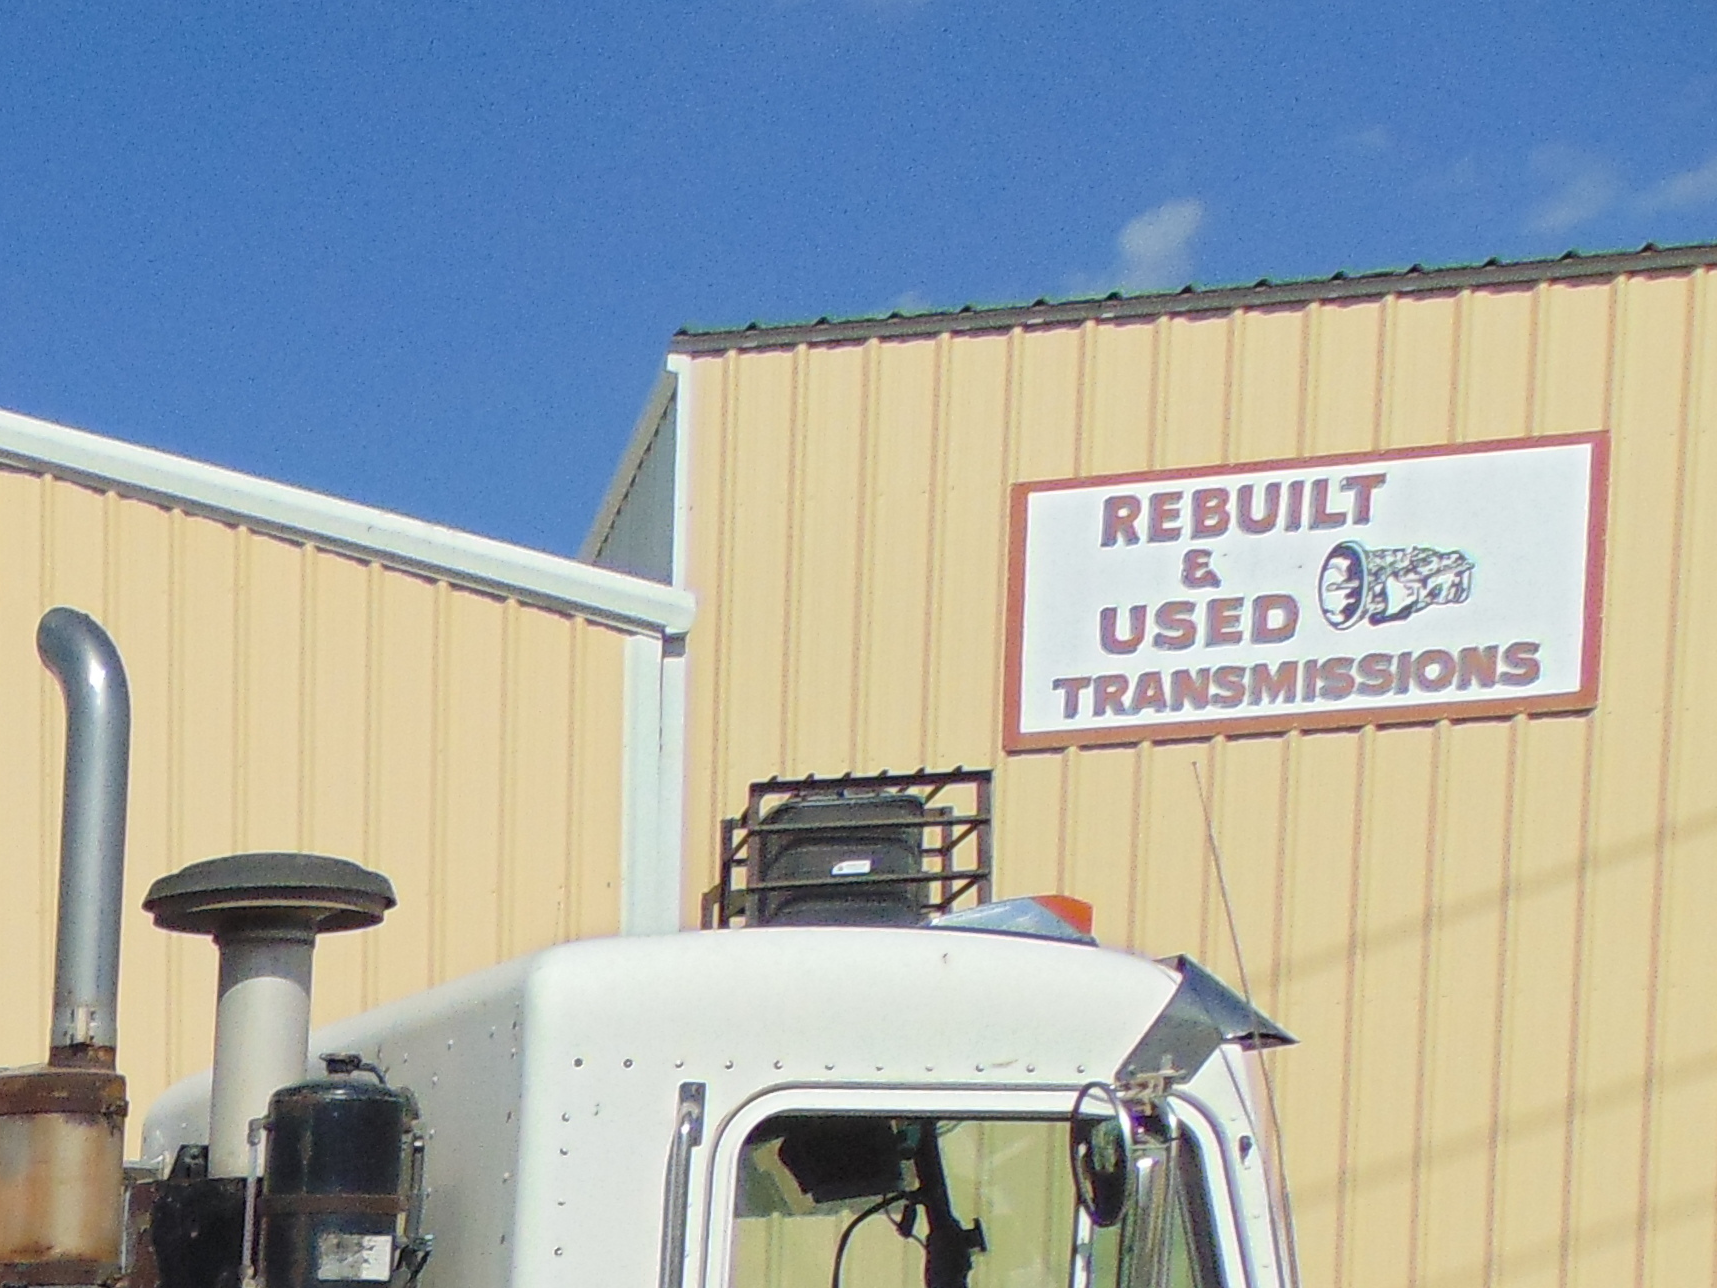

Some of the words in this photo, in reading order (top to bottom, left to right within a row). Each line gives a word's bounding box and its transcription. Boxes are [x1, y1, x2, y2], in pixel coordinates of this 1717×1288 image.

[1099, 473, 1386, 547] REBUILT
[1180, 549, 1222, 589] &
[1098, 595, 1300, 655] USED
[1052, 642, 1541, 720] TRANSMISSIONS
